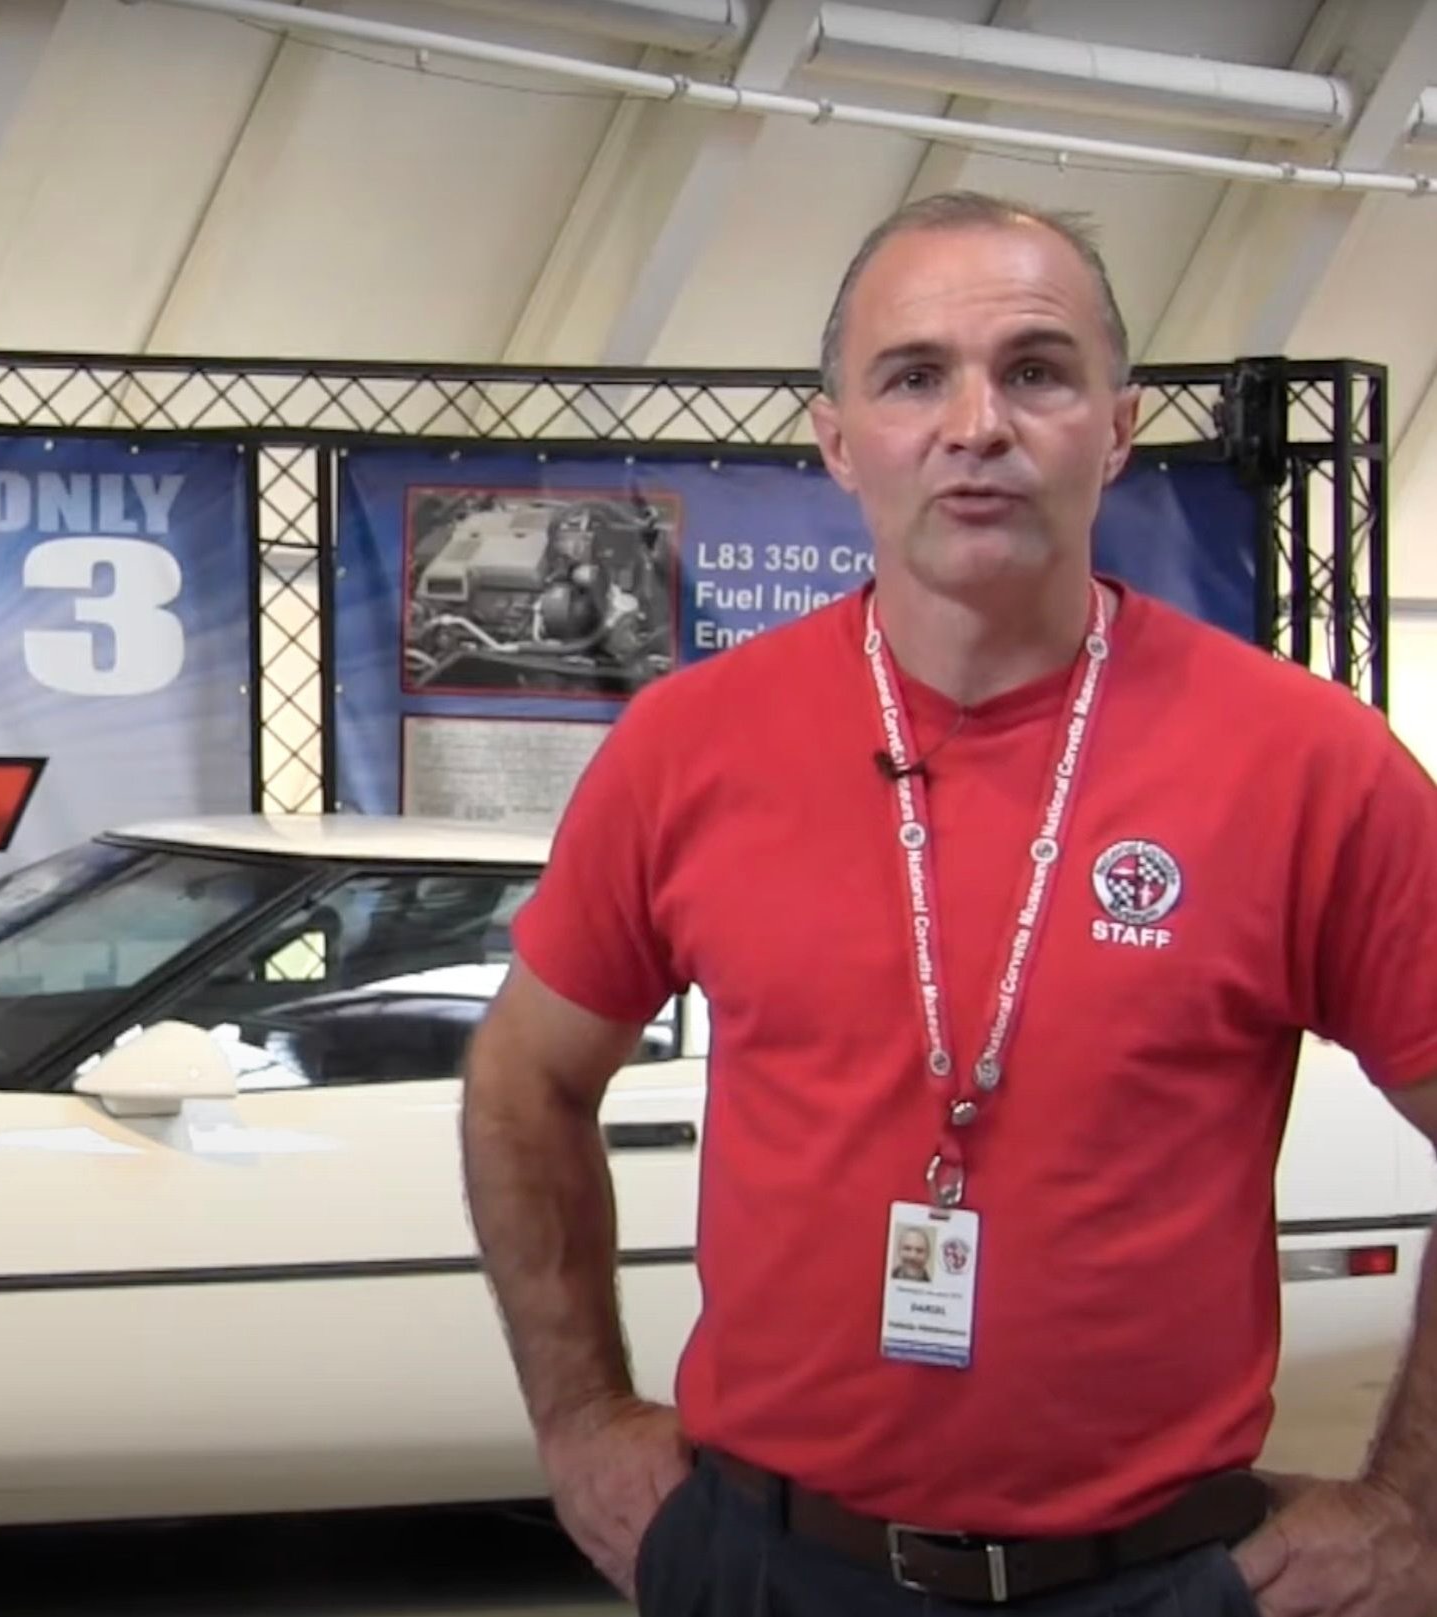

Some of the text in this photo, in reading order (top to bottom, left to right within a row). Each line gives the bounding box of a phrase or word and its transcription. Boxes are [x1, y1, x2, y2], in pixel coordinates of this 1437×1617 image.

[698, 542, 754, 571] L83
[764, 544, 819, 573] 350
[696, 581, 846, 617] Fuel Inje
[695, 621, 765, 649] En
[1092, 919, 1172, 949] STAFF
